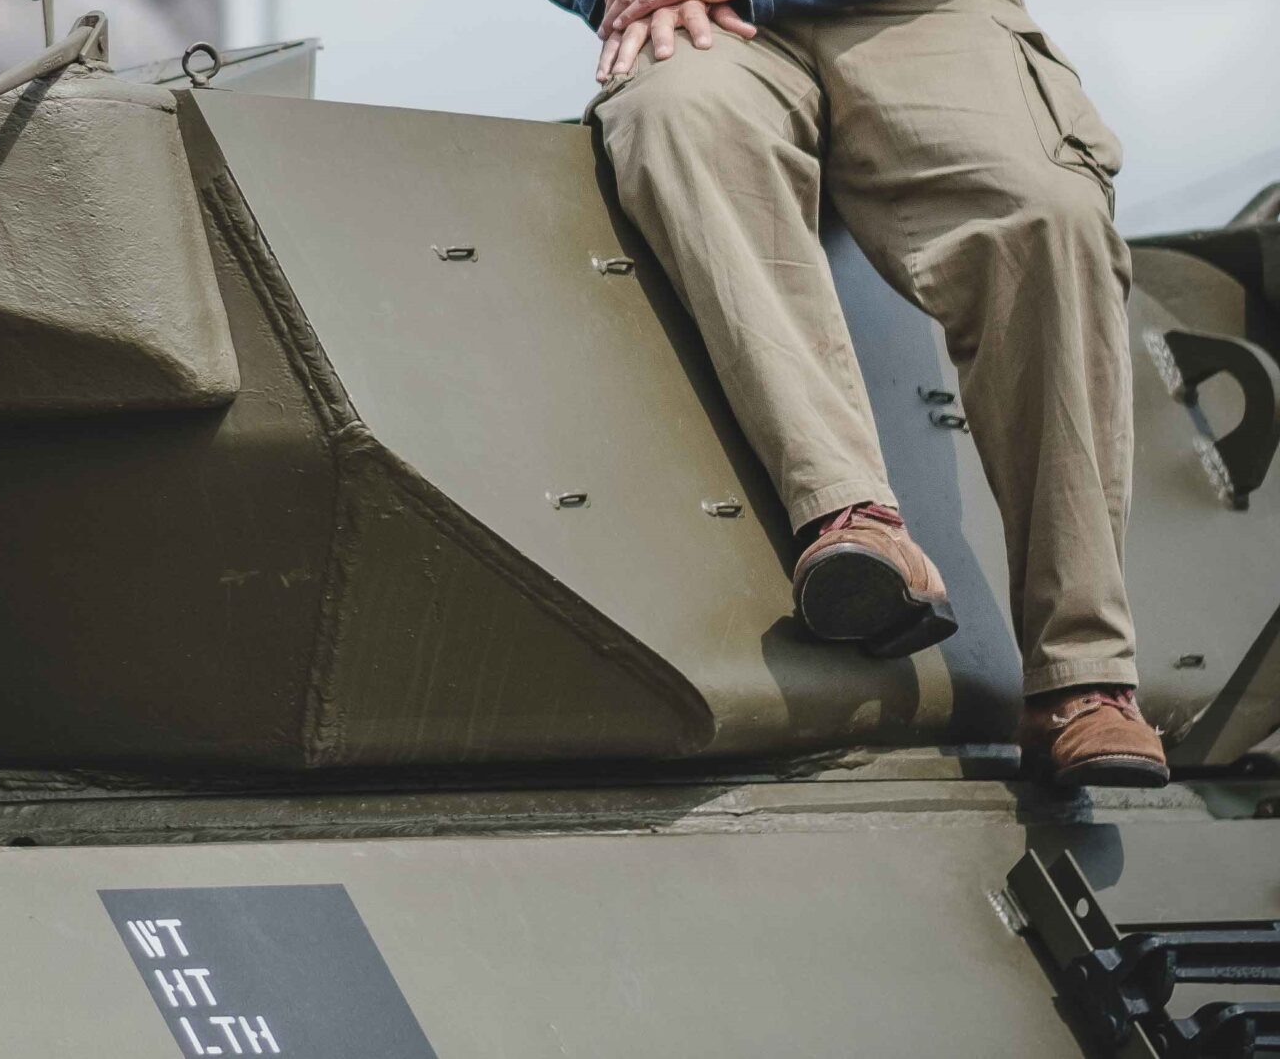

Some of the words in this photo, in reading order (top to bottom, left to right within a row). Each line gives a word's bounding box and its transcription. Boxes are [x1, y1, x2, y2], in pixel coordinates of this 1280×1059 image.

[126, 918, 190, 958] WT
[154, 968, 217, 1007] HT
[179, 1015, 281, 1055] LTH
